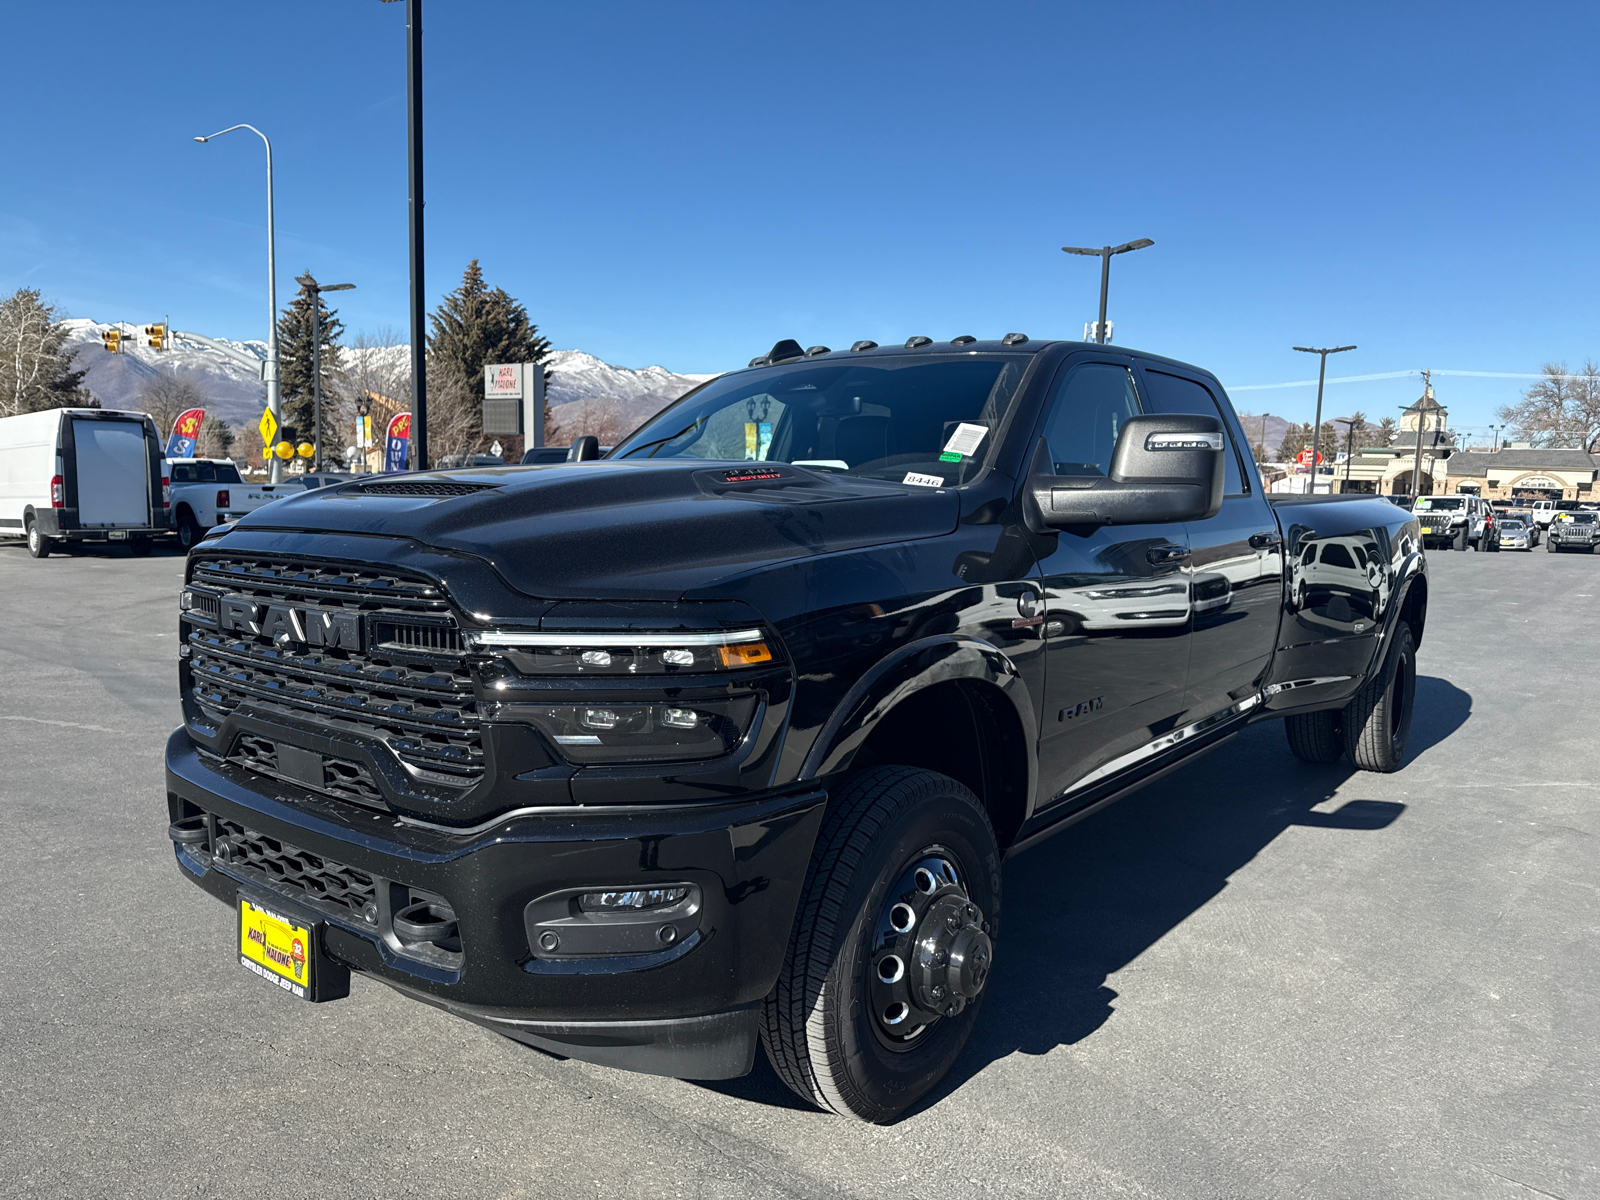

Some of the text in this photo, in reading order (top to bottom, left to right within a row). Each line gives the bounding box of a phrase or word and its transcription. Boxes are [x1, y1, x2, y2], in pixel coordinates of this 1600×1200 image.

[498, 366, 513, 377] KARL
[494, 378, 517, 389] MALONE
[907, 475, 940, 487] 8446
[221, 594, 364, 651] RAM
[1058, 695, 1106, 722] RAM
[248, 927, 263, 945] KARL
[266, 946, 291, 967] MALONE
[241, 956, 304, 998] CHRYSLER DODGE JEEP RAM
